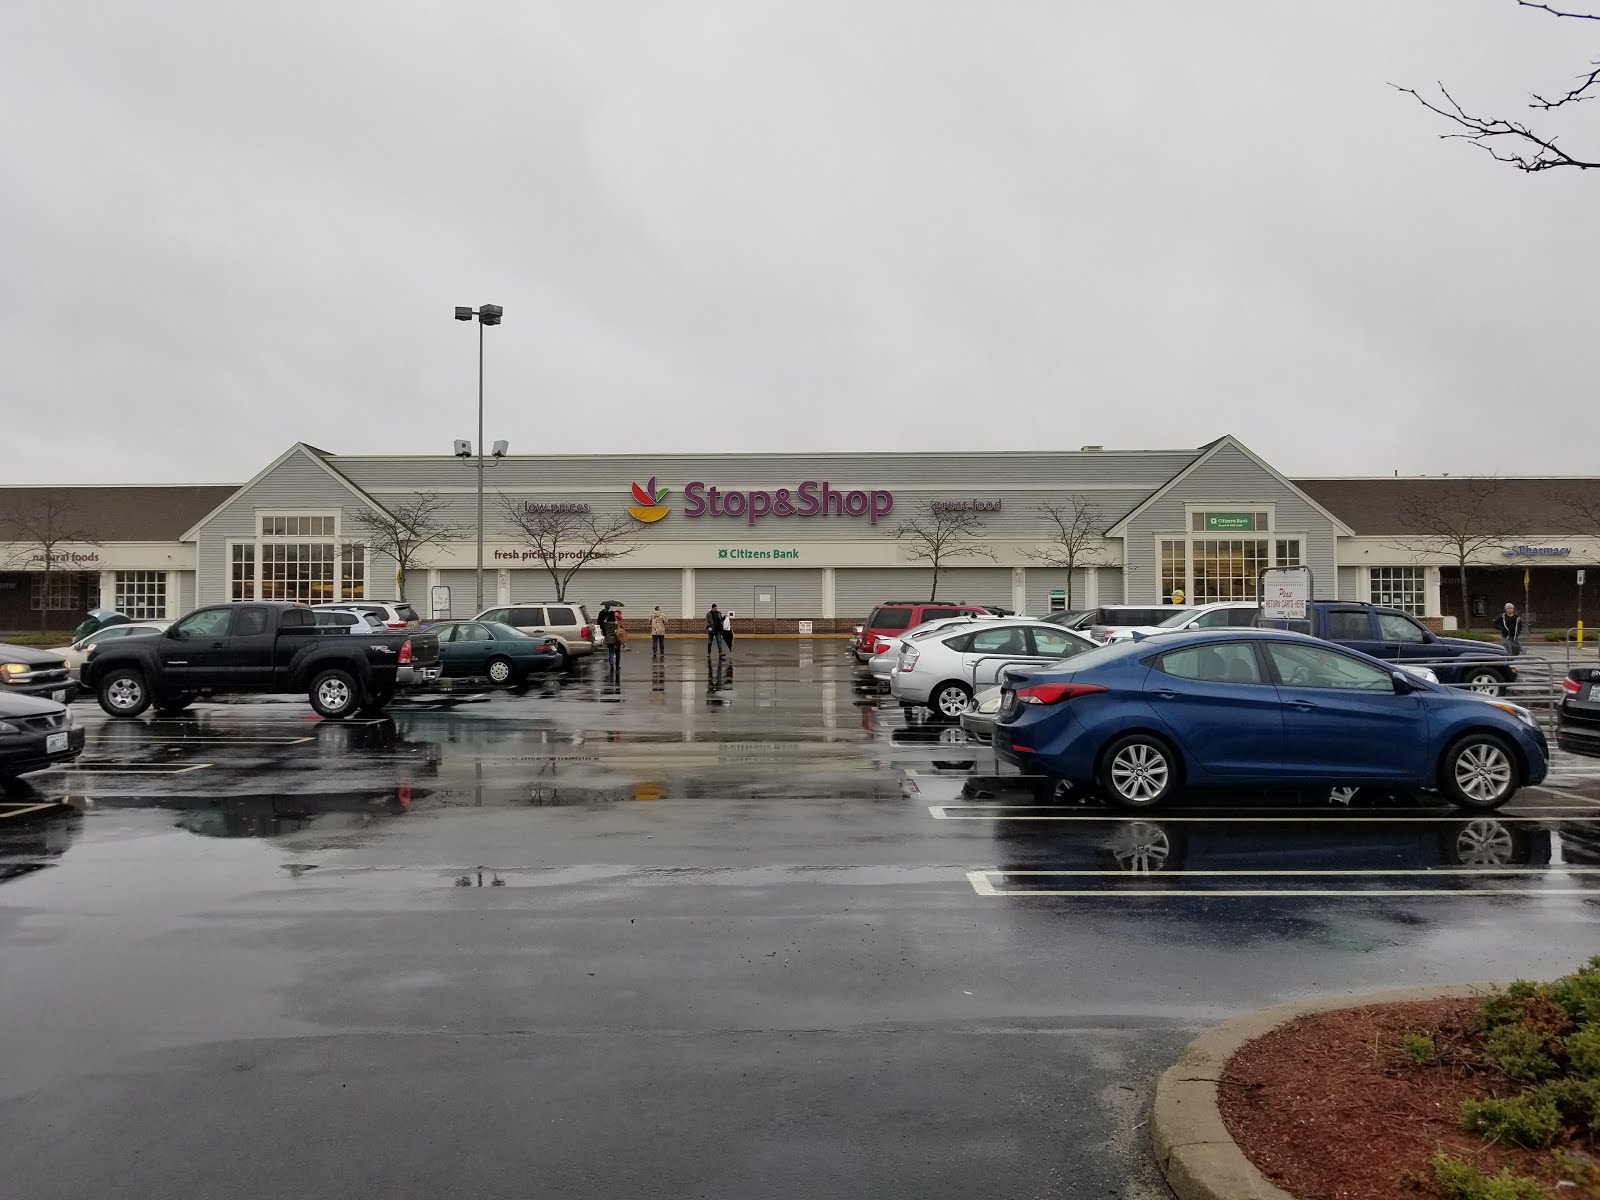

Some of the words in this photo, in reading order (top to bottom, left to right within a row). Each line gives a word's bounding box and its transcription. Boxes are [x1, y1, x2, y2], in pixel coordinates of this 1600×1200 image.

[524, 500, 547, 513] low
[551, 500, 590, 515] prices
[684, 481, 894, 524] Stop&Shop
[934, 500, 968, 513] great
[971, 498, 1002, 511] food
[71, 551, 100, 562] foods
[494, 549, 520, 560] fresh
[522, 549, 556, 562] picked
[729, 548, 771, 559] Citizens
[773, 548, 799, 559] Bank
[1518, 545, 1572, 557] Pharmacy
